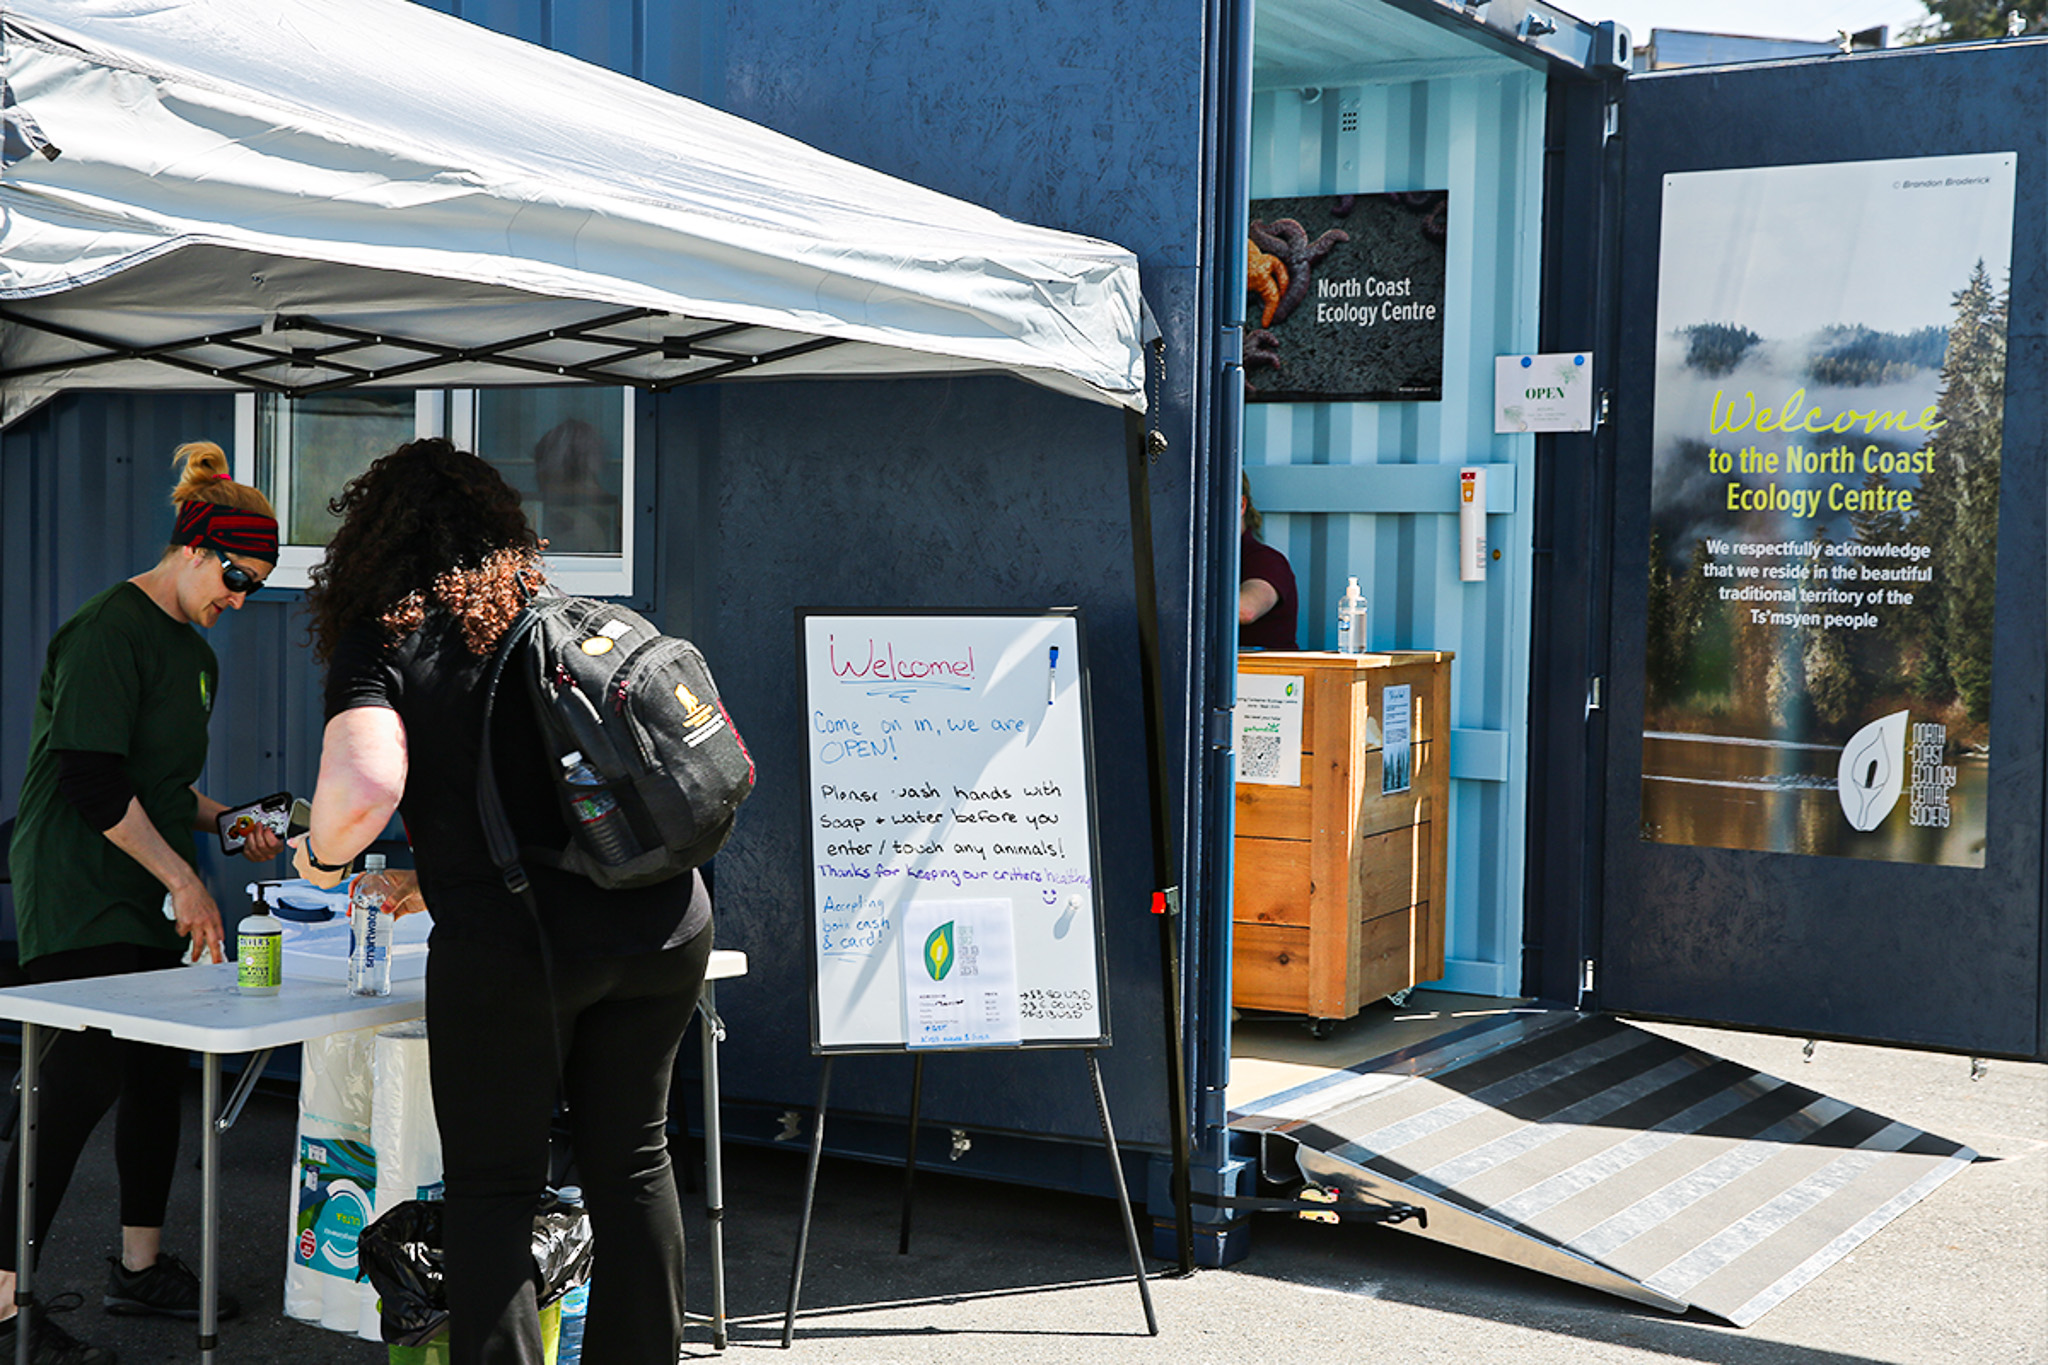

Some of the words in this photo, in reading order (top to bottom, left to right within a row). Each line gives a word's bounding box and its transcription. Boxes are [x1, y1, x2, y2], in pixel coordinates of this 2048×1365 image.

[1902, 180, 1942, 189] Brandon
[1318, 278, 1361, 298] North
[1365, 276, 1411, 297] Coast
[1317, 302, 1377, 326] Ecology
[1382, 301, 1436, 321] Centre
[1525, 387, 1565, 400] OPEN
[1709, 388, 1947, 435] Welcome
[1708, 448, 1733, 474] to
[1740, 446, 1779, 474] the
[1786, 446, 1855, 474] North
[1863, 445, 1936, 475] Coast
[1727, 483, 1822, 518] Ecology
[1828, 483, 1913, 512] Centre
[1706, 540, 1730, 555] We
[1733, 541, 1822, 560] respectfully
[1824, 542, 1931, 561] acknowledge
[1703, 563, 1734, 578] that
[1736, 566, 1760, 578] we
[1762, 563, 1810, 579] reside
[1813, 564, 1828, 580] in
[1831, 565, 1858, 580] the
[1861, 565, 1933, 582] beautiful
[1719, 586, 1797, 602] traditional
[1800, 587, 1864, 608] territory
[1866, 588, 1884, 604] of
[1886, 590, 1914, 605] the
[1750, 608, 1820, 628] Ts'msyen
[1824, 612, 1878, 631] people
[830, 634, 975, 681] Welcome!
[814, 710, 860, 735] Come
[881, 719, 900, 734] on
[947, 718, 979, 732] we
[991, 718, 1026, 733] are
[819, 736, 898, 764] OPEN!
[821, 785, 878, 802] Please
[953, 785, 1012, 800] hands
[1023, 780, 1062, 797] with
[891, 810, 943, 824] water
[951, 807, 1018, 823] before
[1026, 814, 1059, 830] you
[827, 839, 872, 856] enter
[892, 840, 944, 854] touch
[954, 843, 986, 861] any
[993, 837, 1065, 859] animals!
[818, 862, 871, 879] Thanks
[875, 862, 900, 878] for
[963, 869, 988, 879] our
[993, 867, 1042, 882] critters
[856, 916, 890, 930] cash
[840, 929, 882, 949] card!
